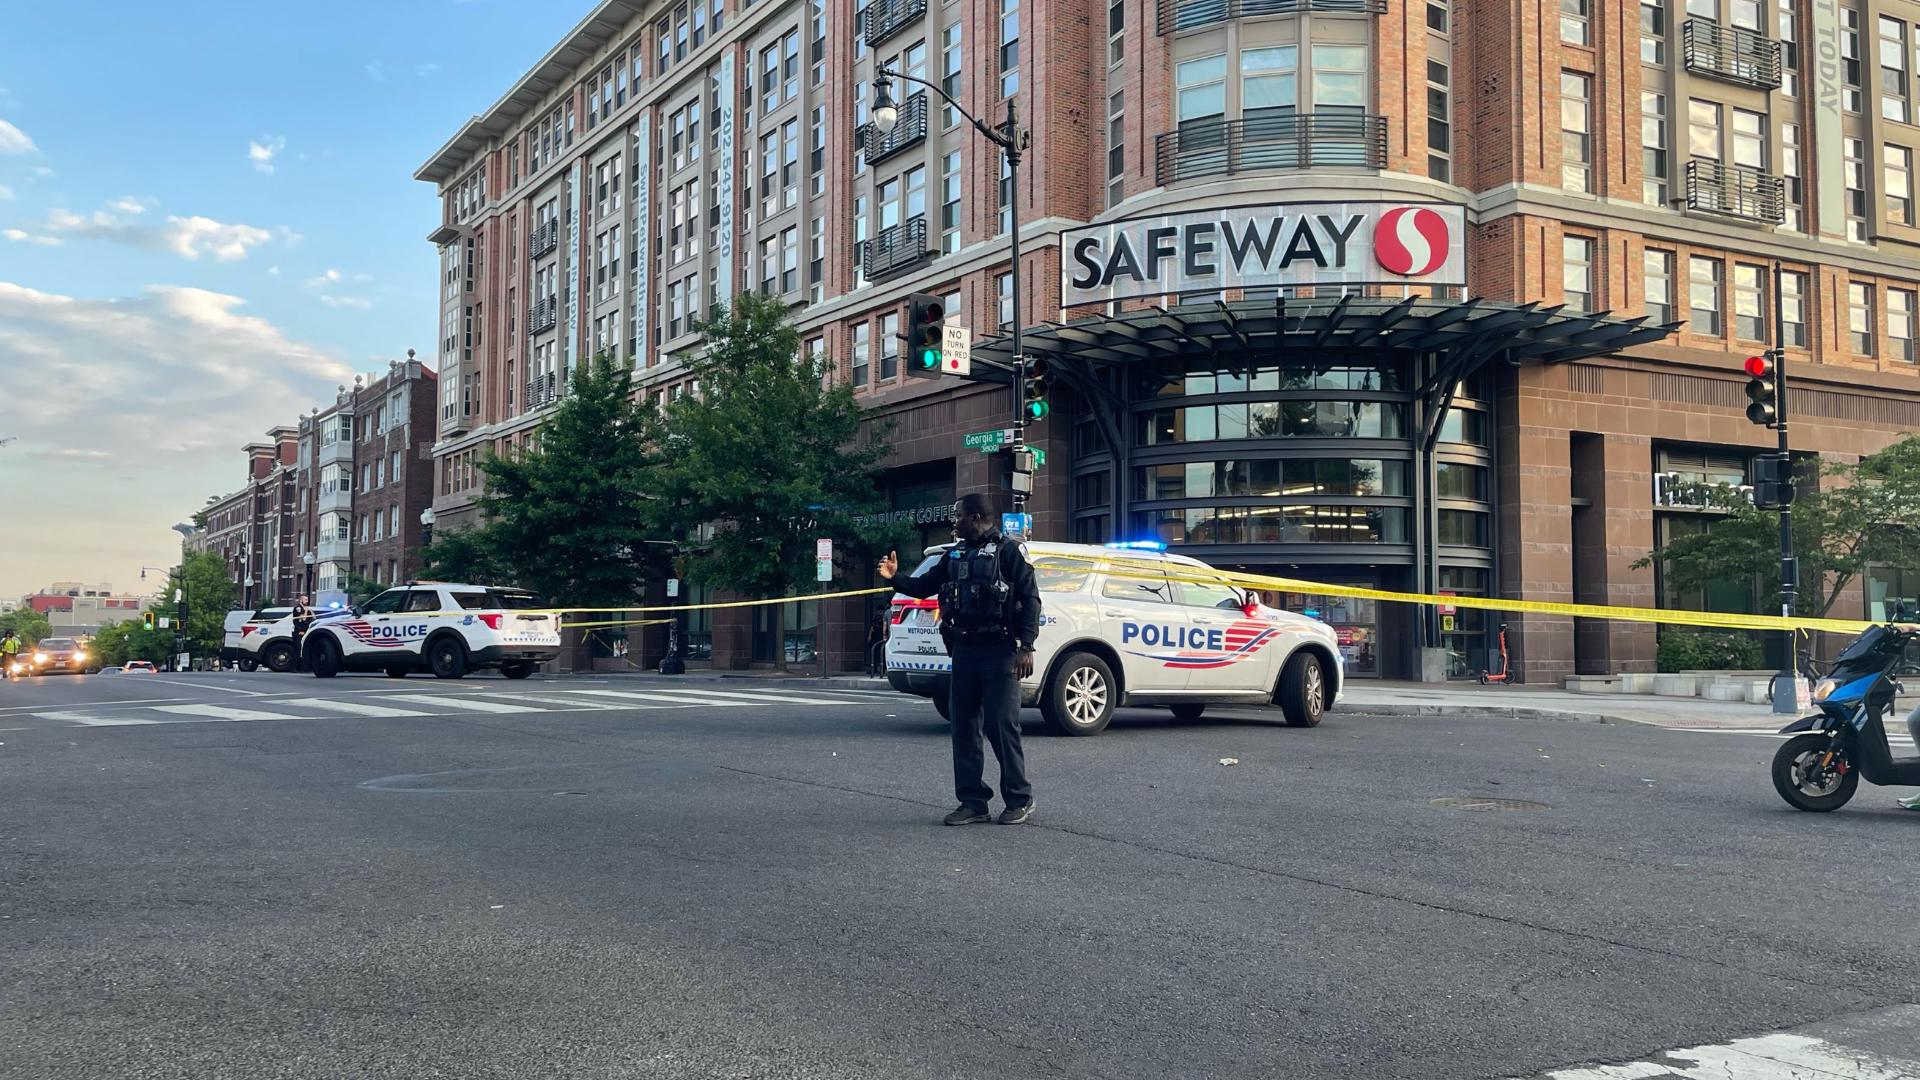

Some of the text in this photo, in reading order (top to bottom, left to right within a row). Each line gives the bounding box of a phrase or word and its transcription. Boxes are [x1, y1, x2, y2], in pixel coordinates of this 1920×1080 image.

[1818, 26, 1838, 116] TODAY
[721, 107, 732, 258] 202.541.9120
[1072, 213, 1368, 290] SAFEWAY
[569, 209, 579, 330] MOVE IN NOW
[949, 329, 962, 339] NO
[947, 340, 964, 349] TURN
[943, 349, 968, 359] ON RED
[965, 433, 993, 446] Georgia
[917, 504, 957, 524] COFFE
[372, 624, 428, 638] POLICE
[907, 627, 940, 635] METROPOLIT
[1122, 622, 1223, 651] POLICE
[917, 645, 938, 655] POLICE
